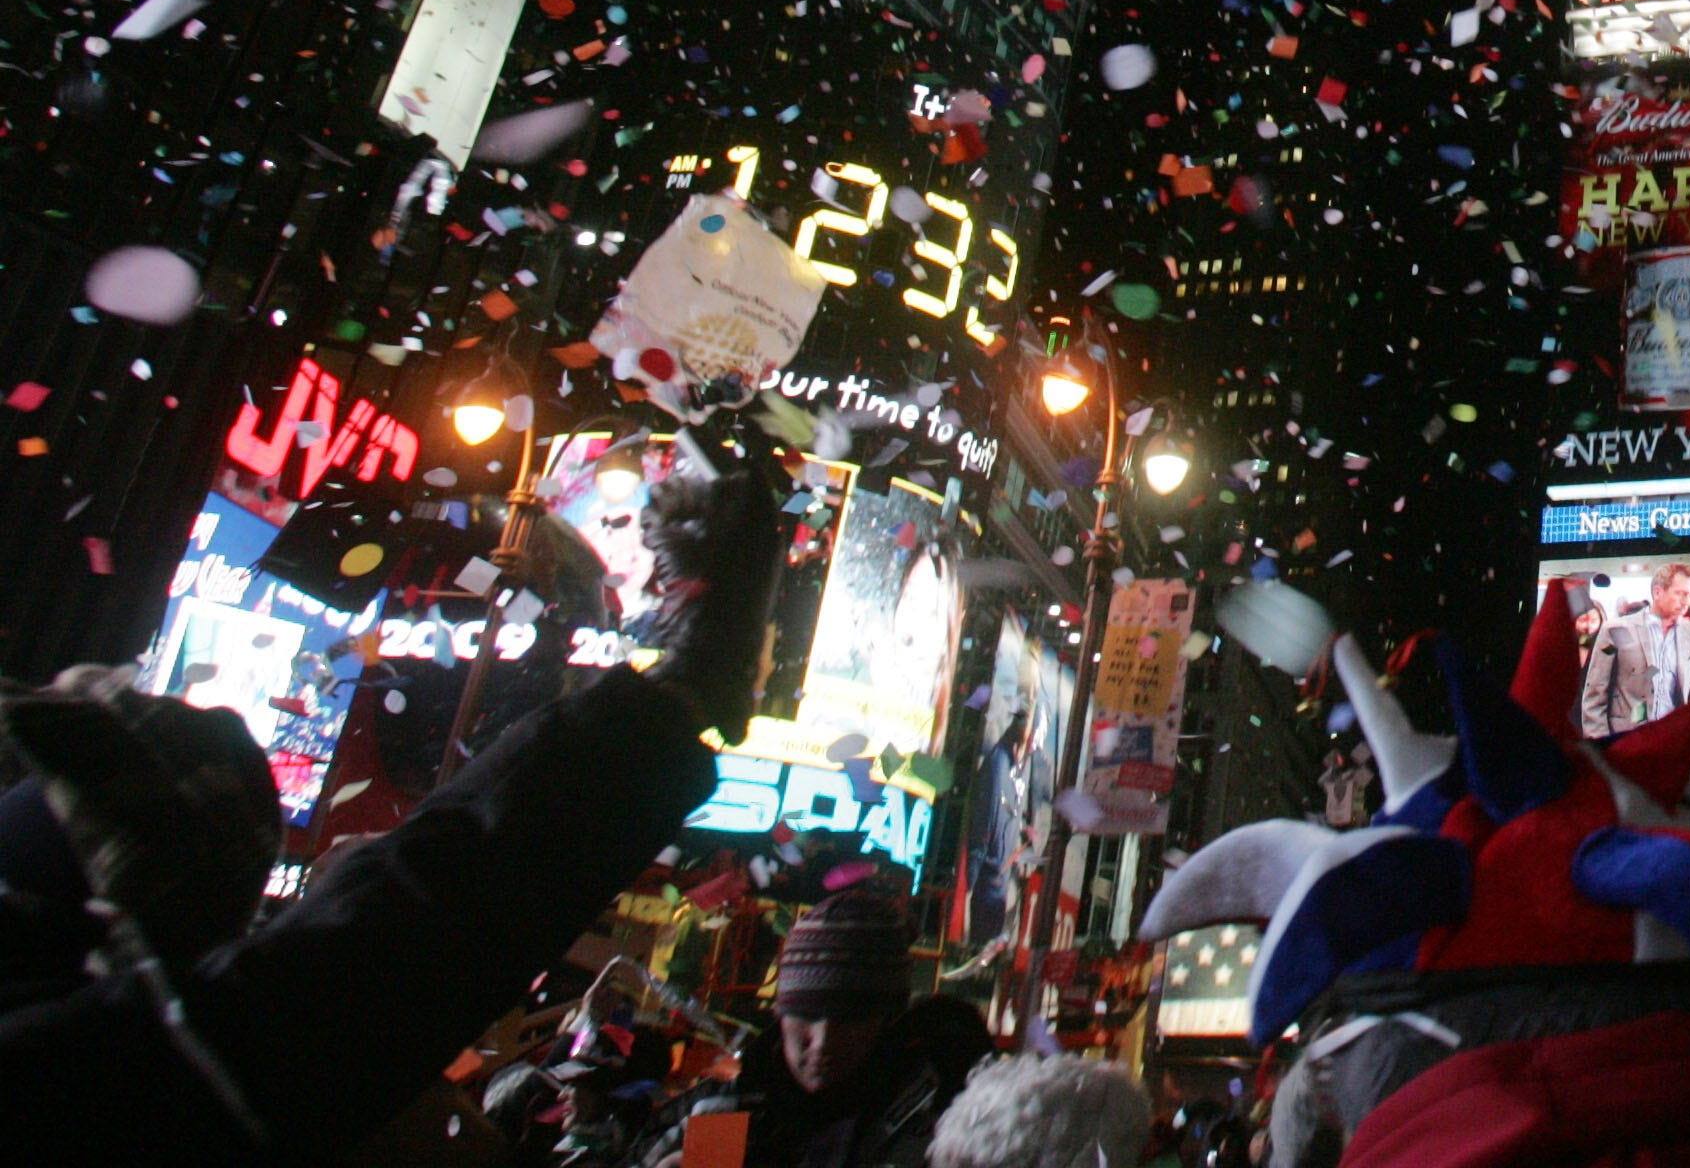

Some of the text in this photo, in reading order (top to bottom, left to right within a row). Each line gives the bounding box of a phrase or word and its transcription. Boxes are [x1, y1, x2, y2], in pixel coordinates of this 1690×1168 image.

[669, 155, 698, 172] AM
[666, 173, 693, 189] PM
[760, 369, 829, 401] our
[838, 374, 920, 429] time
[928, 405, 954, 443] to
[1564, 428, 1666, 468] NEW
[1578, 510, 1639, 535] News
